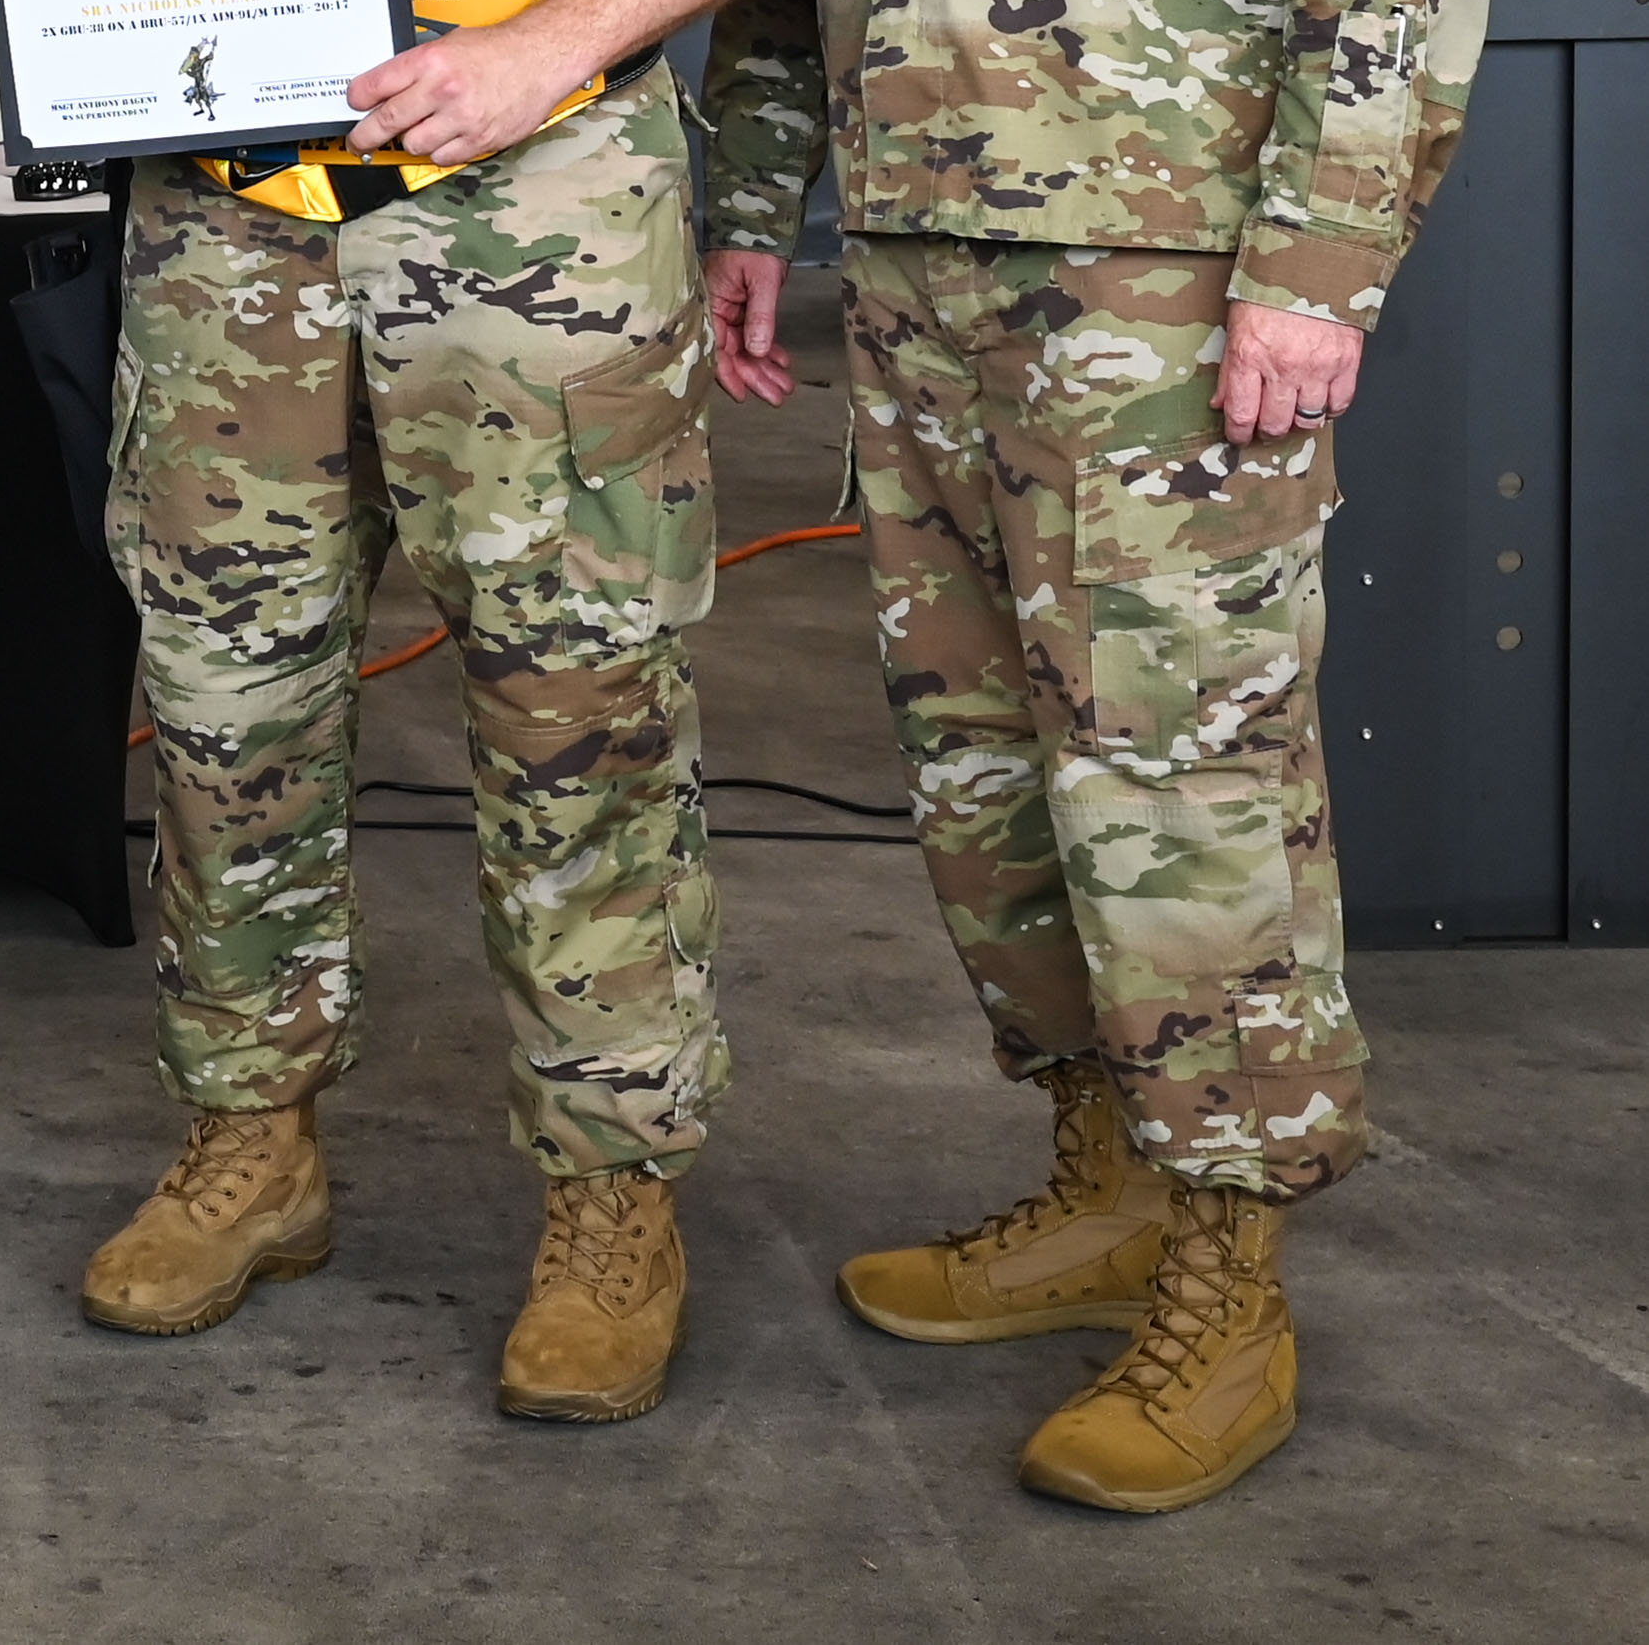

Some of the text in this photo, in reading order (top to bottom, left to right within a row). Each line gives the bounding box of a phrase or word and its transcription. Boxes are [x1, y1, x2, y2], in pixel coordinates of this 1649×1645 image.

[41, 26, 57, 38] 2X
[60, 22, 104, 36] GBU-38
[108, 21, 125, 33] ON
[128, 19, 137, 31] A
[272, 4, 304, 17] TIME
[314, 0, 349, 12] 20:17
